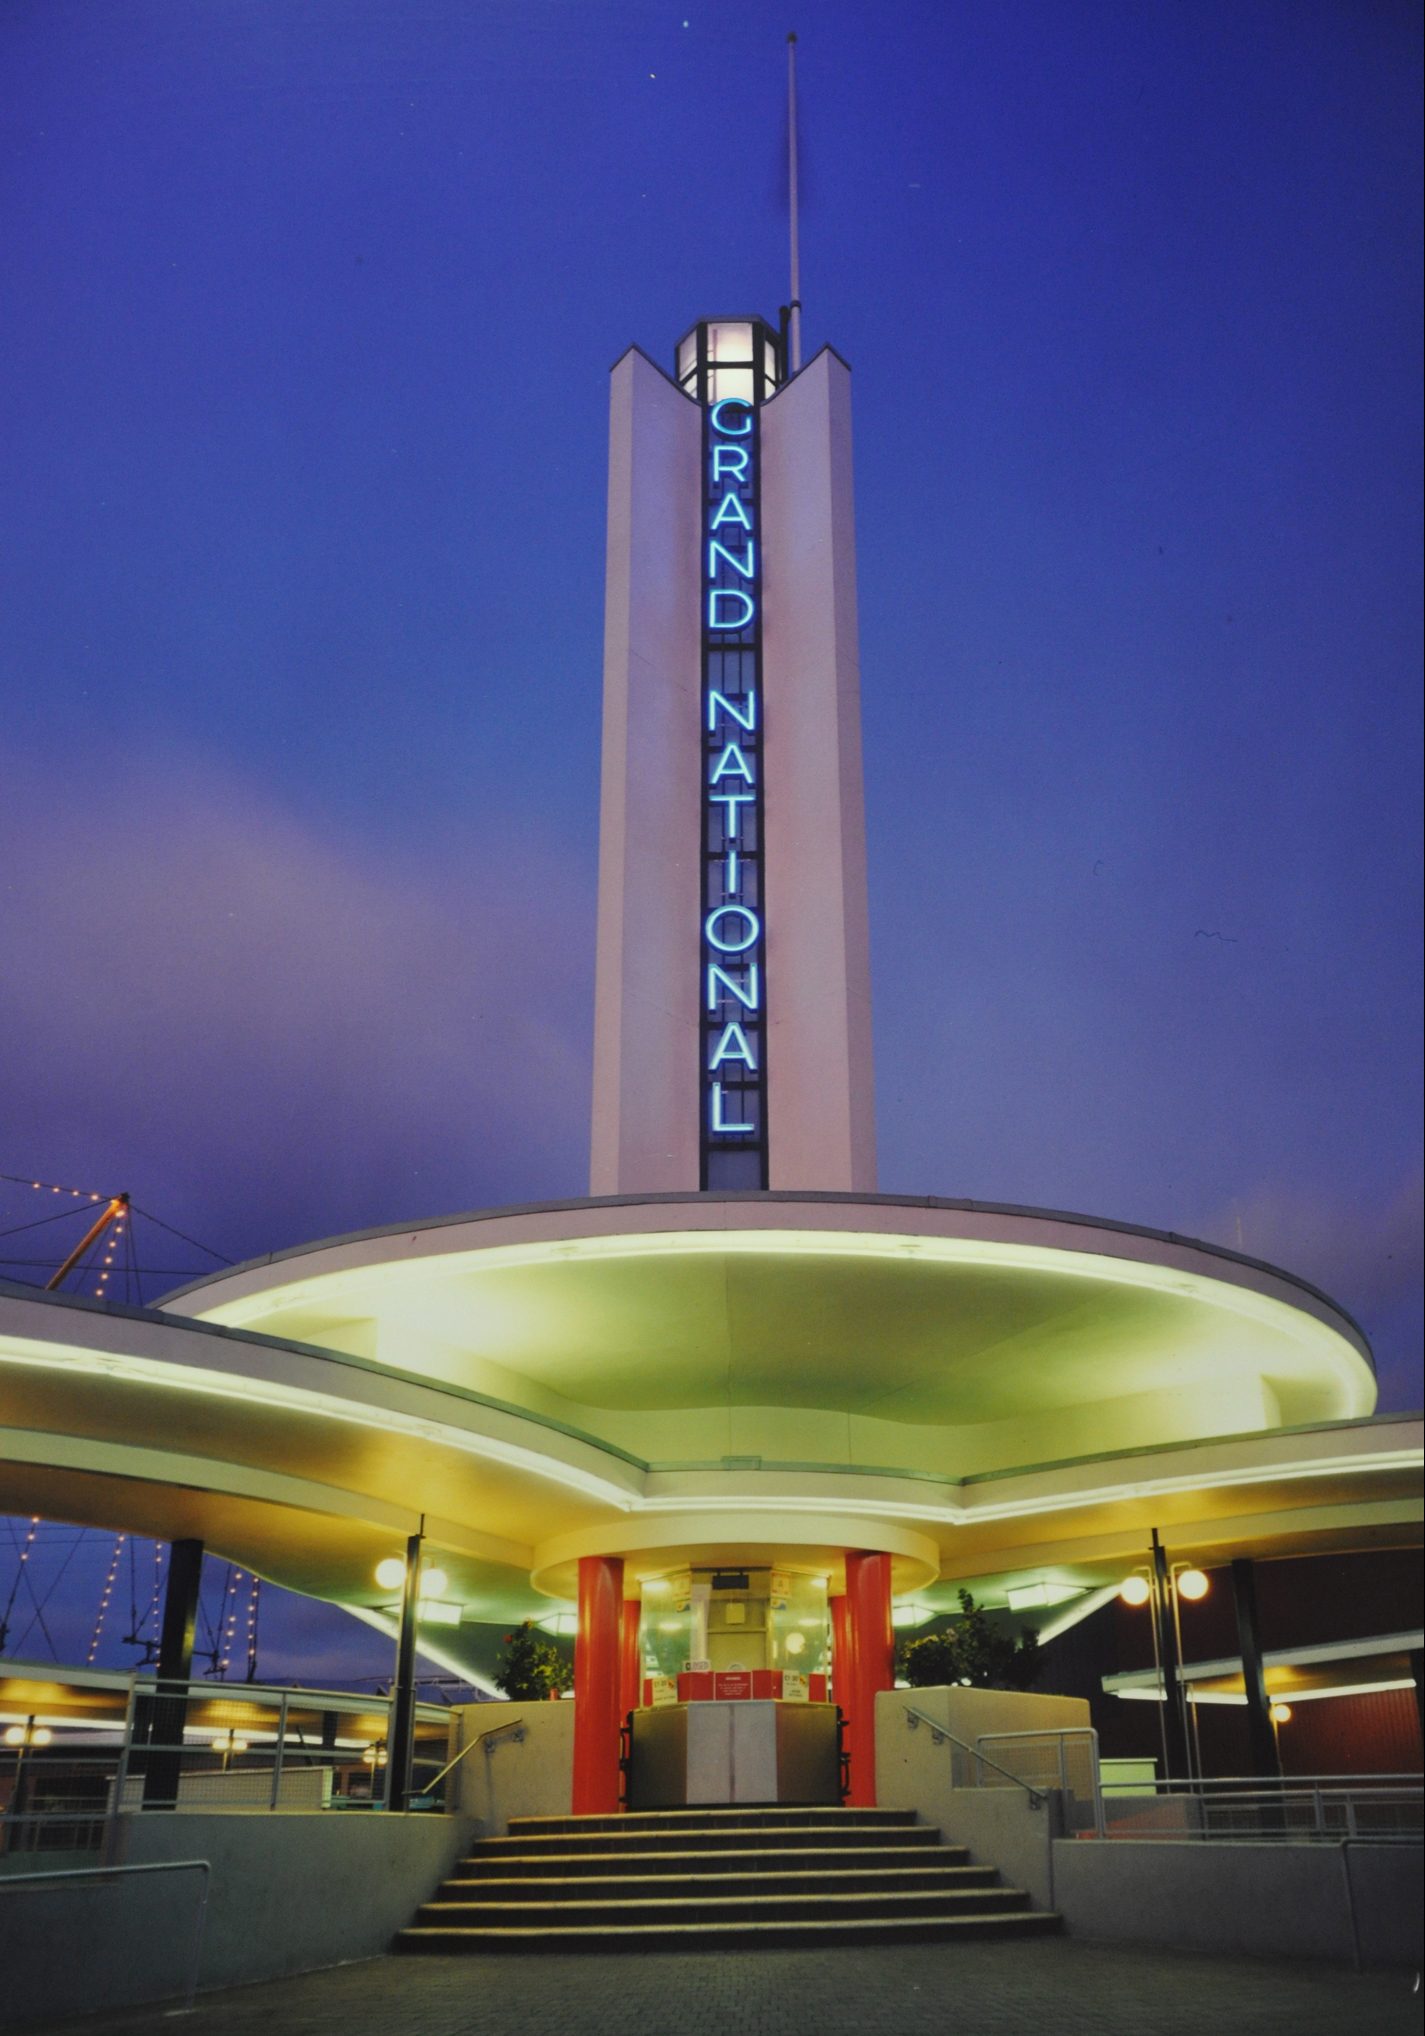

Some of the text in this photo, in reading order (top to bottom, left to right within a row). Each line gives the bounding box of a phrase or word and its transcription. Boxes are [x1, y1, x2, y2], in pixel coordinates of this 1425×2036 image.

[705, 397, 760, 1133] GRAND NATIONAL
[685, 1661, 709, 1671] COSED
